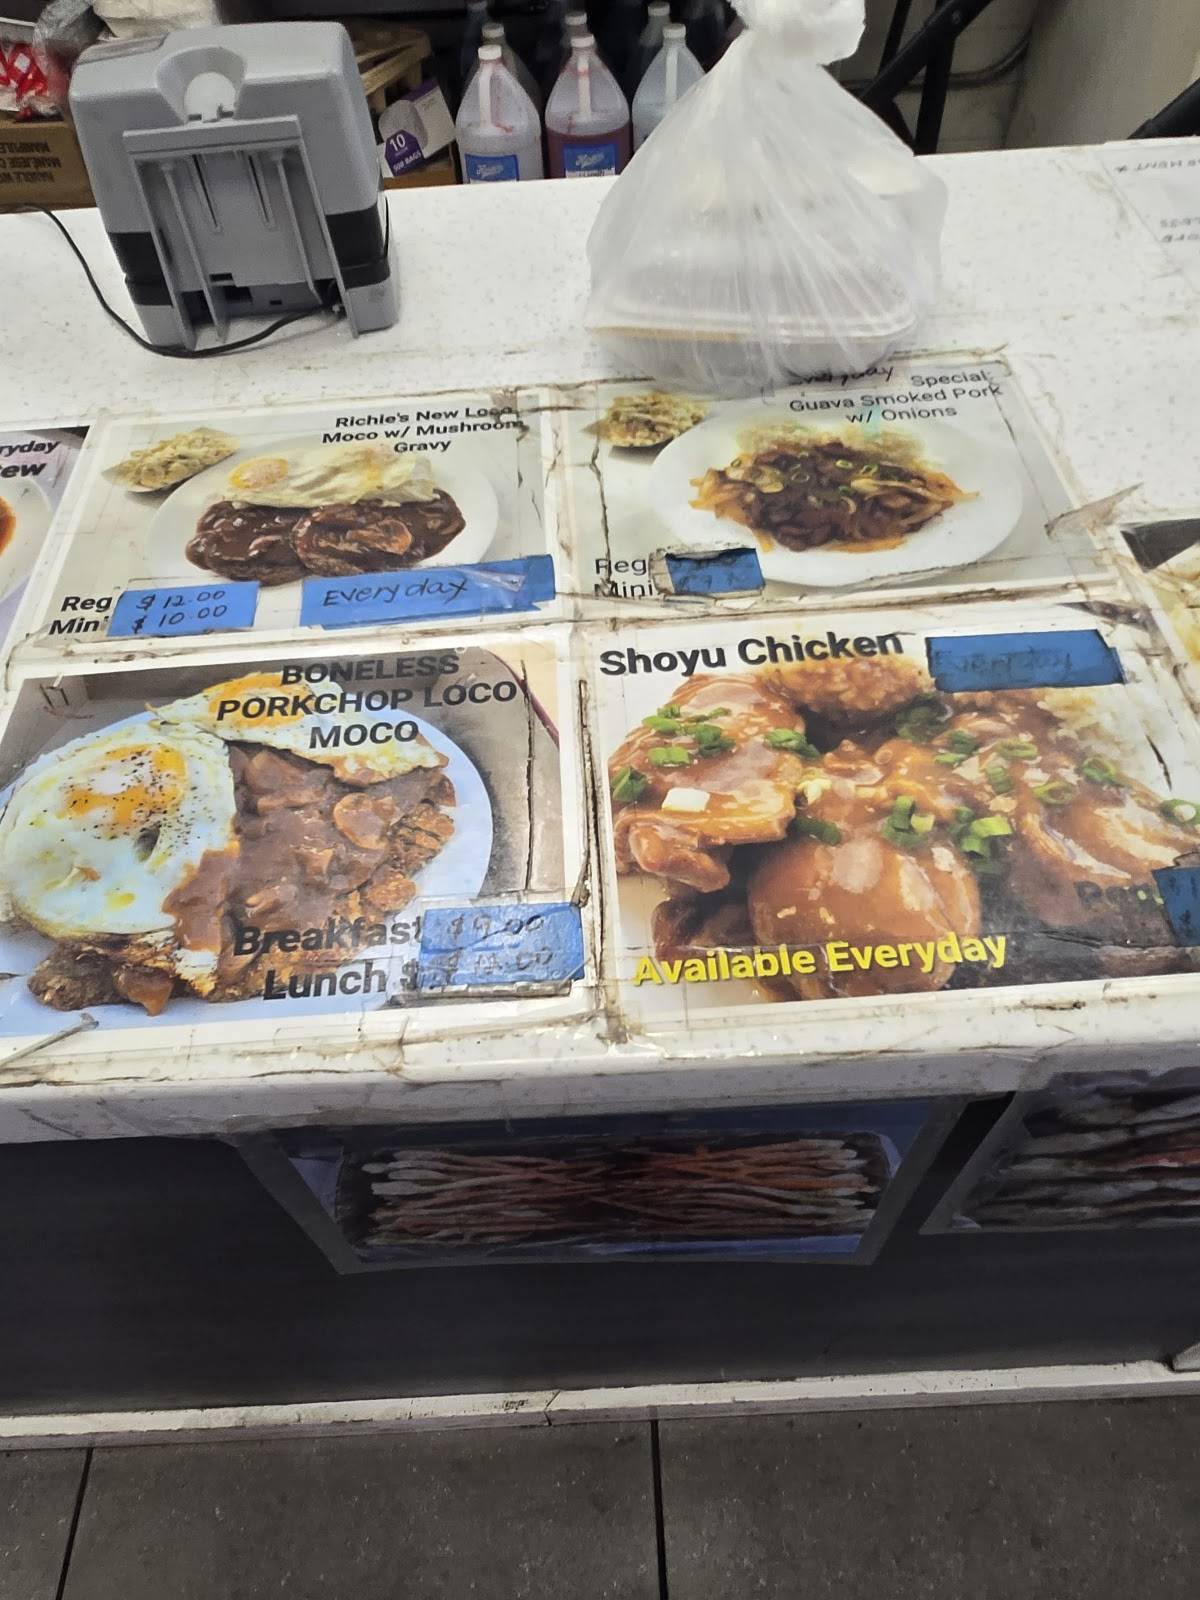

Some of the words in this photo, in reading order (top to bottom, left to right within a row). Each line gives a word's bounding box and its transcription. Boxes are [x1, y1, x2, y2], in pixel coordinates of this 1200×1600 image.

[390, 134, 405, 151] 10
[789, 399, 854, 412] Guava
[860, 389, 947, 407] Smoked
[952, 385, 1003, 399] Pork
[335, 412, 410, 428] Richie's
[416, 409, 459, 421] New
[846, 411, 872, 423] w/
[881, 405, 957, 422] Onions
[322, 431, 378, 444] Moco
[384, 426, 410, 438] w/
[394, 440, 451, 454] Gravy
[0, 463, 47, 478] ew
[595, 558, 647, 576] Reg
[61, 596, 112, 613] Reg
[49, 615, 109, 636] Min
[600, 647, 727, 677] Shoyu
[737, 631, 904, 666] Chicken
[281, 655, 460, 686] BONELESS
[216, 688, 414, 721] PORKCHOP
[423, 681, 517, 708] LOCO
[309, 721, 419, 749] MOCO
[233, 911, 422, 956] Breakfast
[633, 943, 817, 987] Available
[828, 931, 1007, 974] Everyday
[264, 958, 387, 1001] Lunch
